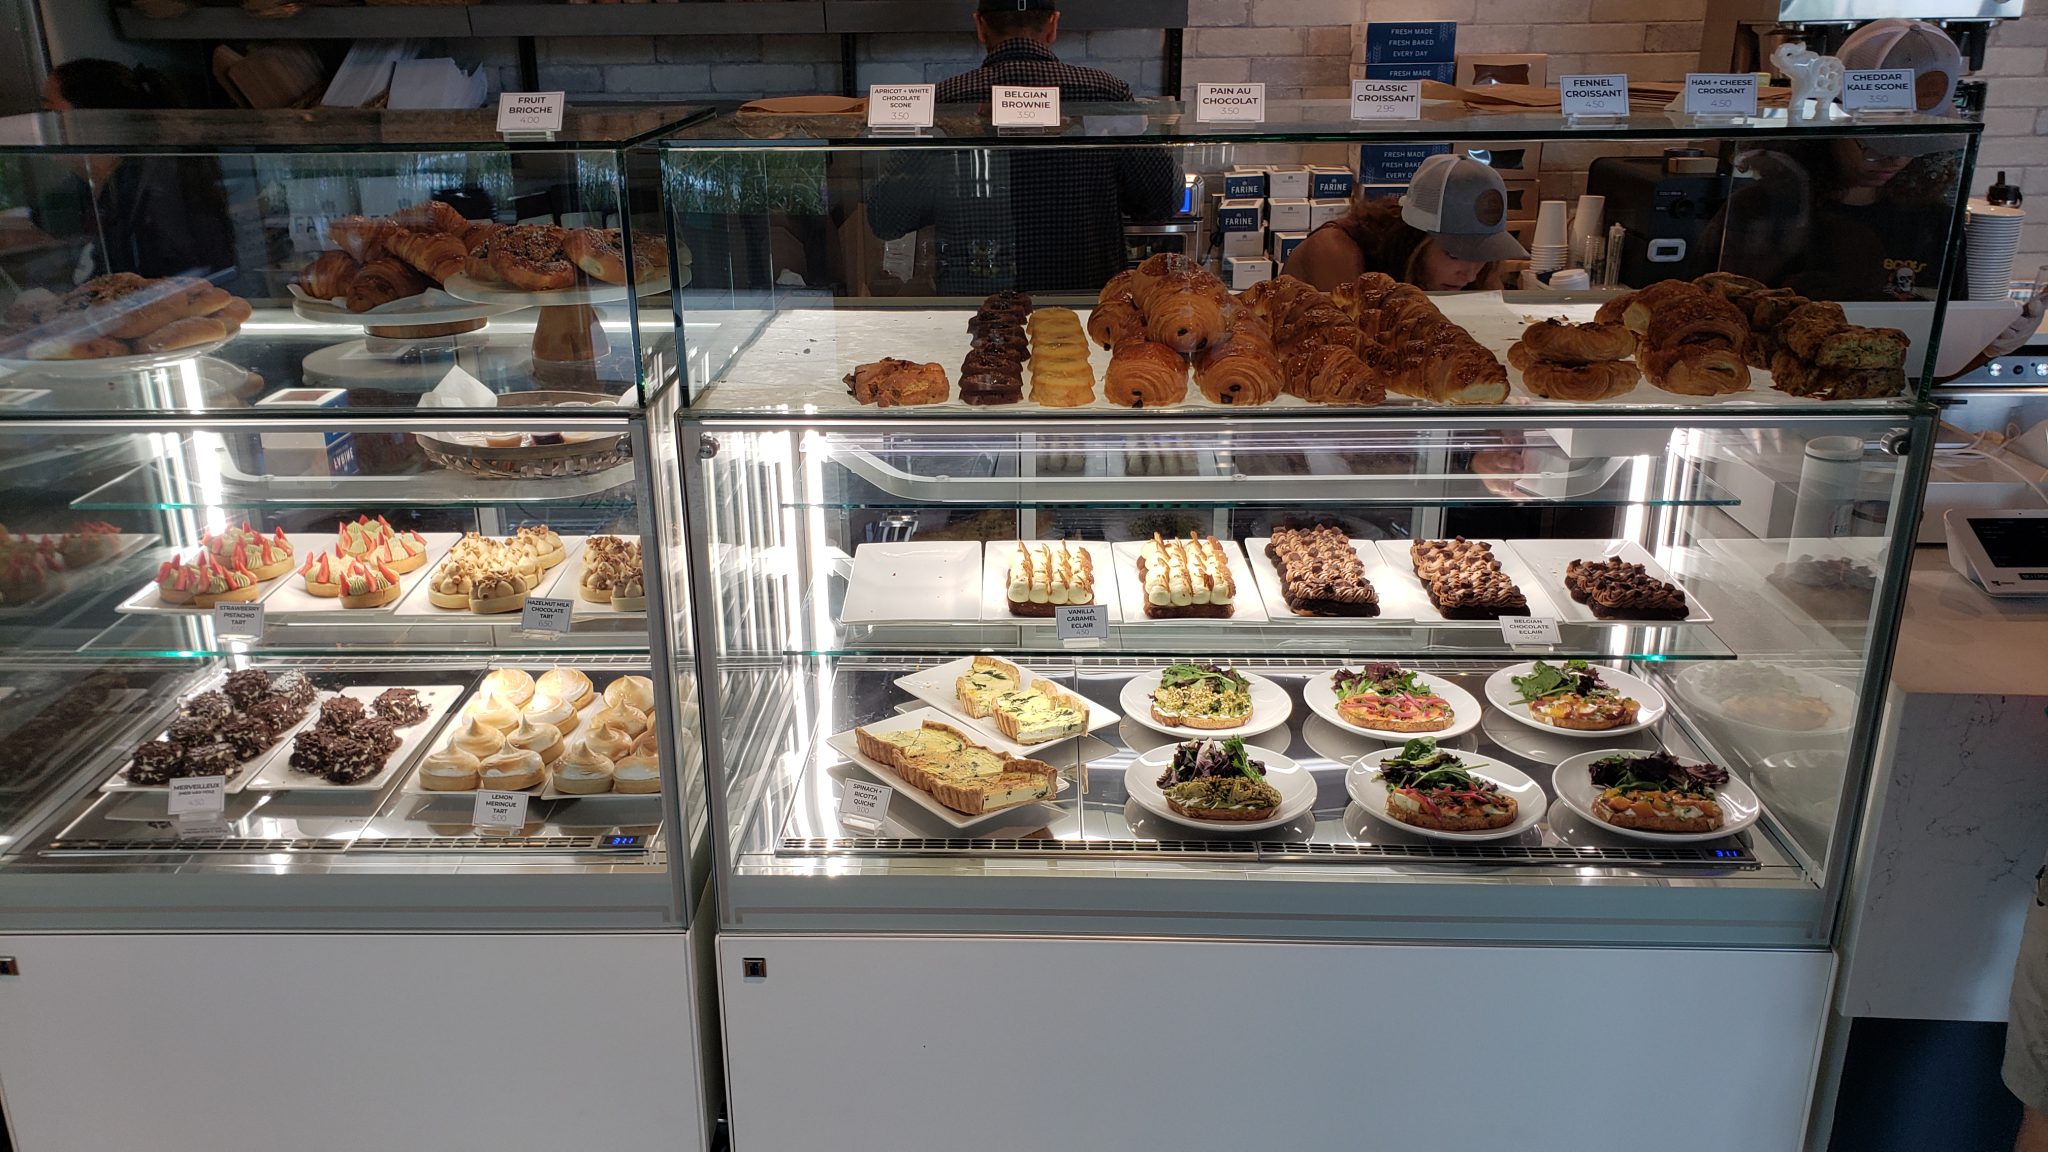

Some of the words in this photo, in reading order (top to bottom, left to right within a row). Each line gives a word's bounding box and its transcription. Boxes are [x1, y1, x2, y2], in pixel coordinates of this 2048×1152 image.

[1852, 73, 1902, 81] CHEDDAR
[1573, 79, 1613, 87] FENNEL
[1847, 83, 1873, 91] KALE
[1874, 82, 1909, 91] SCONE
[1210, 87, 1234, 95] PAIN
[1236, 87, 1251, 95] AU
[1365, 84, 1408, 92] CLASSIC
[1697, 87, 1746, 95] CROISSANT
[1004, 90, 1048, 99] BELGIAN
[1565, 89, 1622, 98] CROISSANT
[518, 96, 546, 104] FRUIT
[1202, 97, 1259, 105] CHOCOLAT
[1356, 94, 1416, 103] CROISSANT
[1001, 100, 1051, 109] BROWNIE
[509, 106, 553, 114] BRIOCHE
[1231, 185, 1259, 194] FARINE
[1319, 183, 1347, 191] FARINE
[1225, 217, 1253, 226] FARINE
[531, 606, 564, 614] CHOCOLATE
[173, 782, 220, 791] MERVEILLEUX
[852, 783, 879, 794] SPINACH
[854, 791, 878, 801] RICOTTA
[485, 800, 517, 808] MERINGUE
[853, 798, 876, 808] QUICHE
